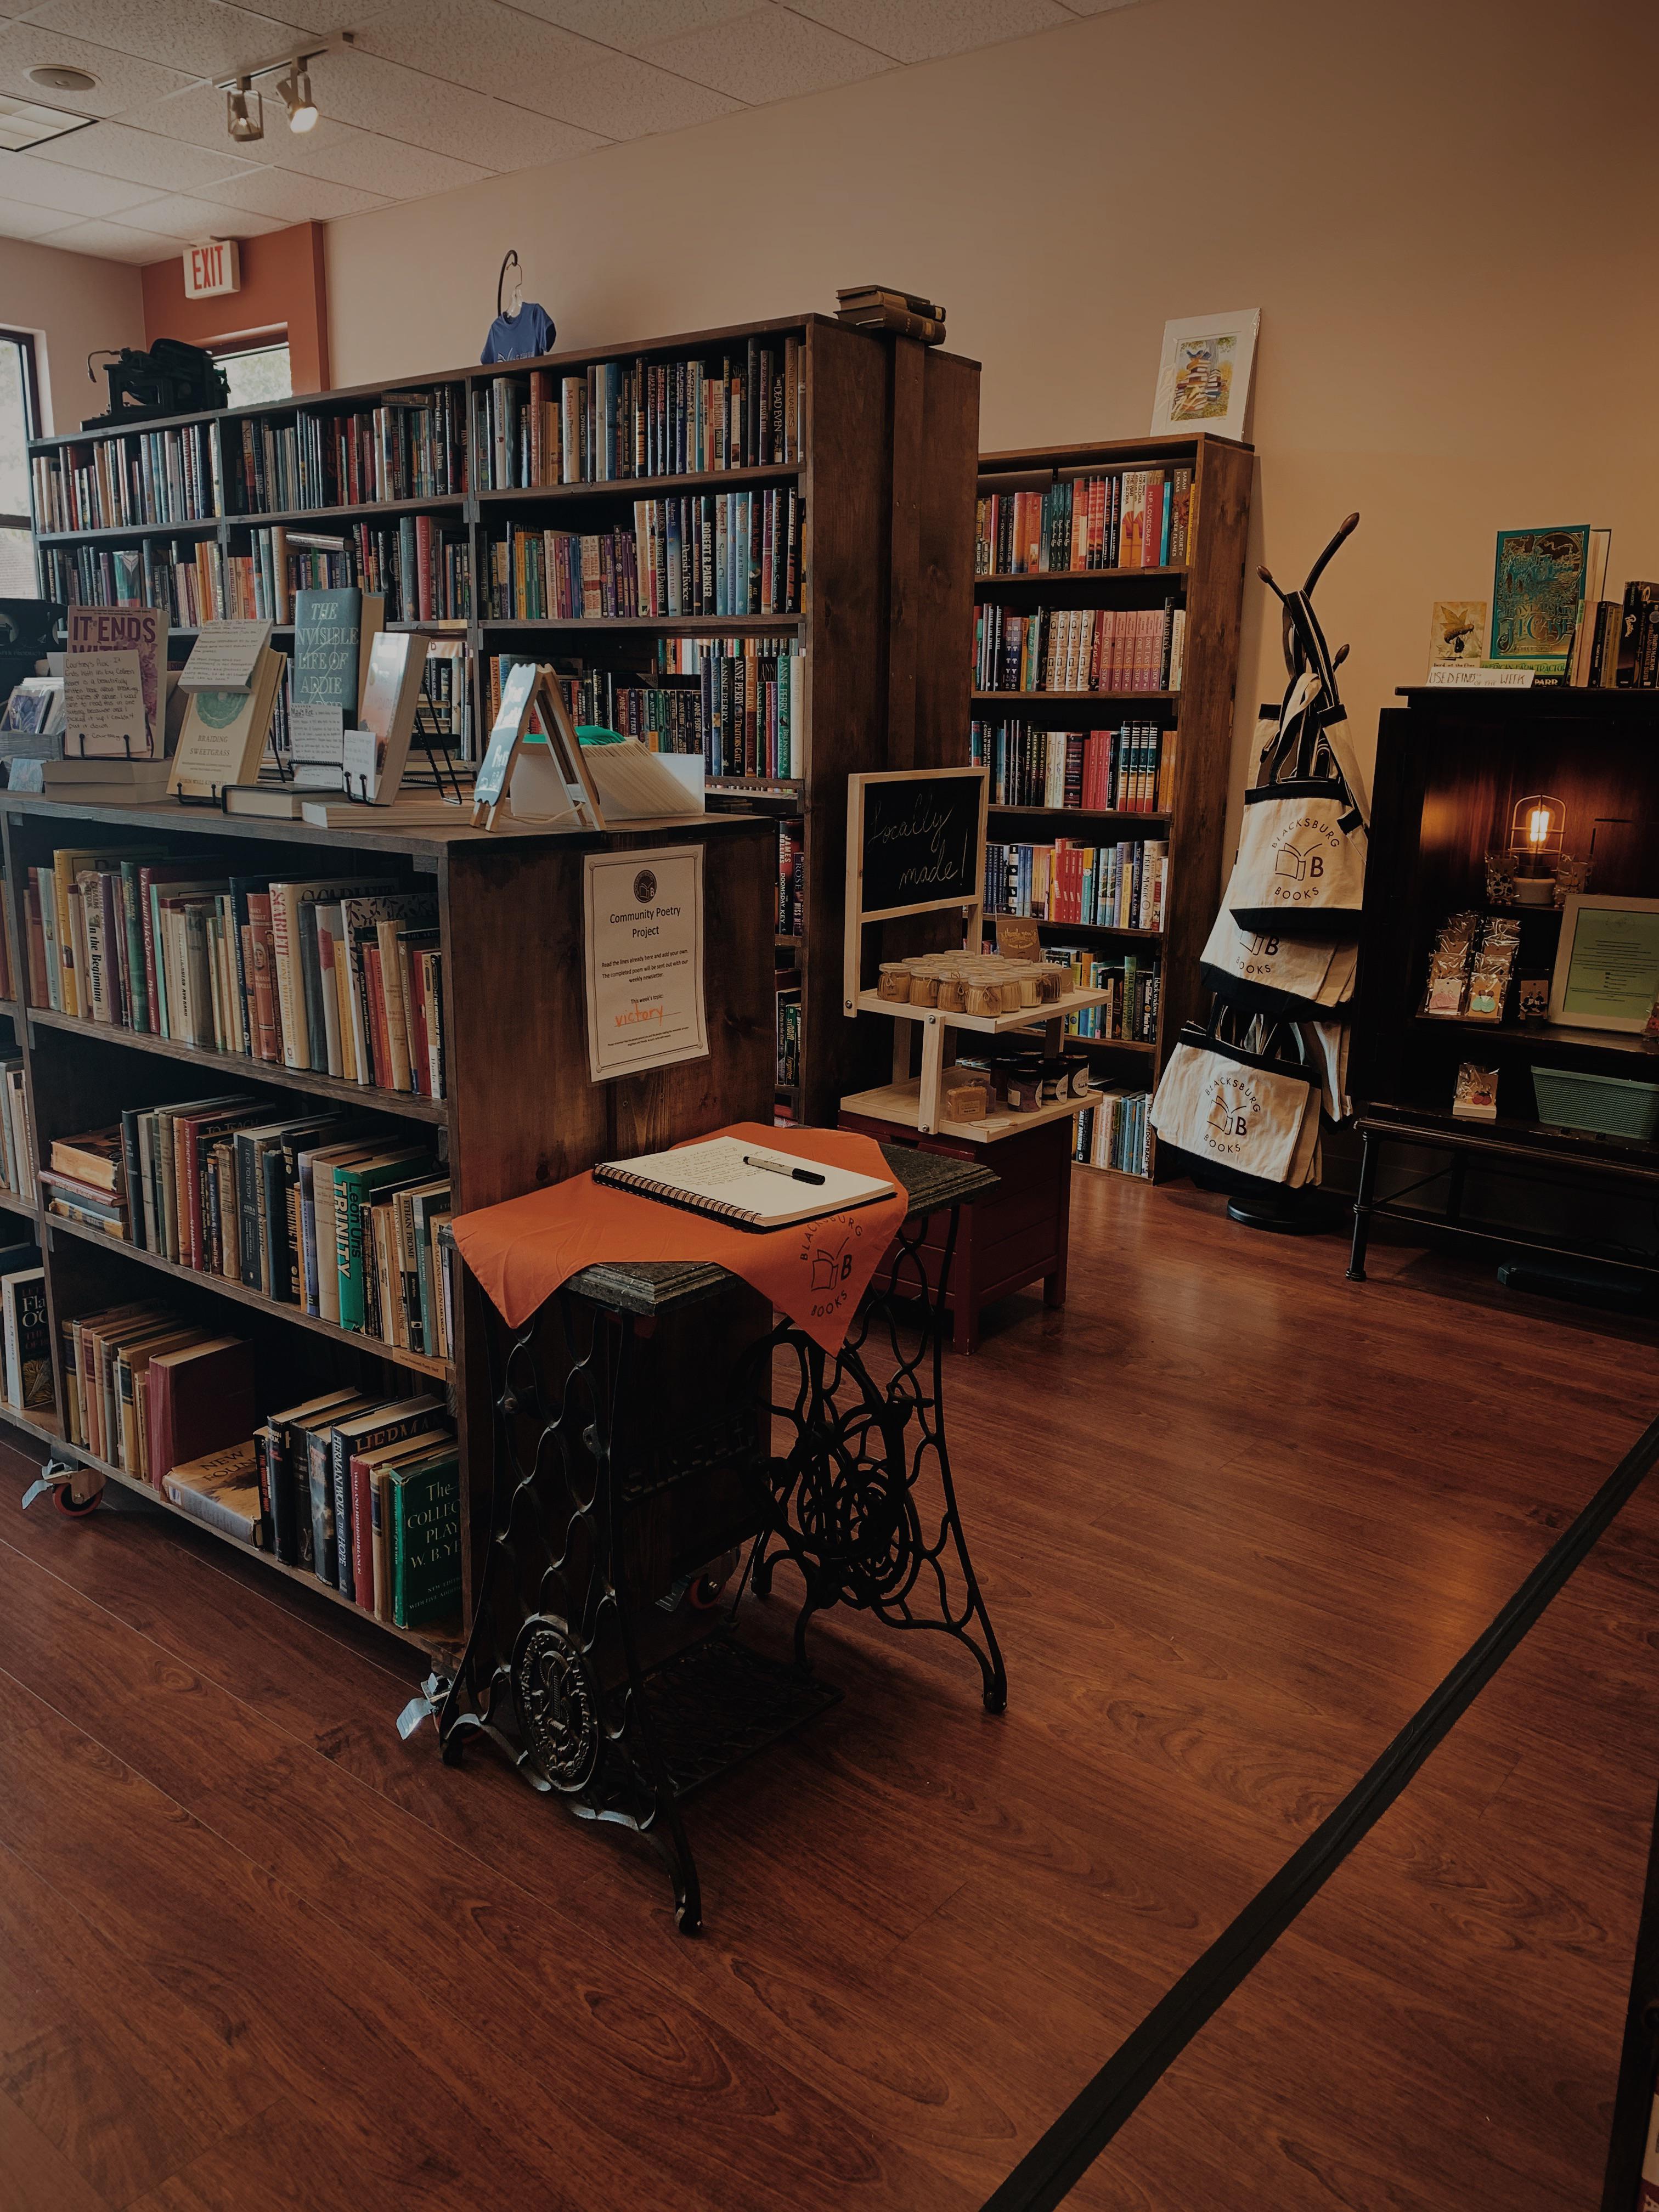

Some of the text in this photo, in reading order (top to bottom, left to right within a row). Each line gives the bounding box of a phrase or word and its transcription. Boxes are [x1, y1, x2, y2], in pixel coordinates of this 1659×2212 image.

[192, 245, 224, 290] EXIT
[774, 386, 782, 409] DEAD
[682, 544, 691, 601] Perish Twice
[716, 543, 725, 599] Spare Change
[311, 602, 338, 620] THE
[73, 616, 156, 644] IT ENDS
[298, 652, 348, 670] LIFE OF
[491, 661, 499, 683] JAMES
[735, 659, 743, 681] ANNE
[300, 676, 343, 695] ADDIE
[1429, 672, 1454, 684] USED
[1455, 673, 1476, 683] FIND
[1500, 674, 1526, 685] WEEK
[735, 682, 743, 707] PERRY
[780, 689, 788, 714] PERRY
[198, 735, 228, 743] BRAIDING
[189, 748, 230, 757] SWEETGRASS
[733, 747, 742, 764] GATE
[1271, 817, 1340, 849] BLACKSBURG
[1310, 856, 1324, 878] B
[1274, 887, 1319, 901] BOOKS
[271, 889, 289, 957] SCARLETT
[610, 905, 681, 924] Community Poetry
[90, 935, 99, 951] the
[632, 926, 659, 939] Project
[1265, 935, 1280, 956] B
[610, 969, 631, 978] completed
[1235, 956, 1272, 975] BOOKS
[91, 953, 103, 1003] Beginning
[614, 1003, 663, 1028] victory
[1205, 1076, 1261, 1113] BLACKSBURG
[206, 1118, 259, 1135] TO TEACH
[1235, 1116, 1248, 1137] B
[1203, 1134, 1241, 1154] BOOKS
[334, 1181, 351, 1280] TRINITY
[348, 1182, 362, 1259] Leon Uris
[403, 1199, 415, 1262] ETHAN FROME
[841, 1254, 853, 1280] B
[811, 1290, 848, 1317] BOOKS
[199, 1451, 244, 1471] NEW
[332, 1434, 343, 1488] HERMAN
[263, 1491, 269, 1499] OF
[426, 1480, 453, 1501] The
[336, 1491, 345, 1520] WOUK
[337, 1538, 347, 1567] HOPE
[410, 1553, 427, 1569] W.
[431, 1548, 442, 1560] B.
[427, 1584, 440, 1593] NEW
